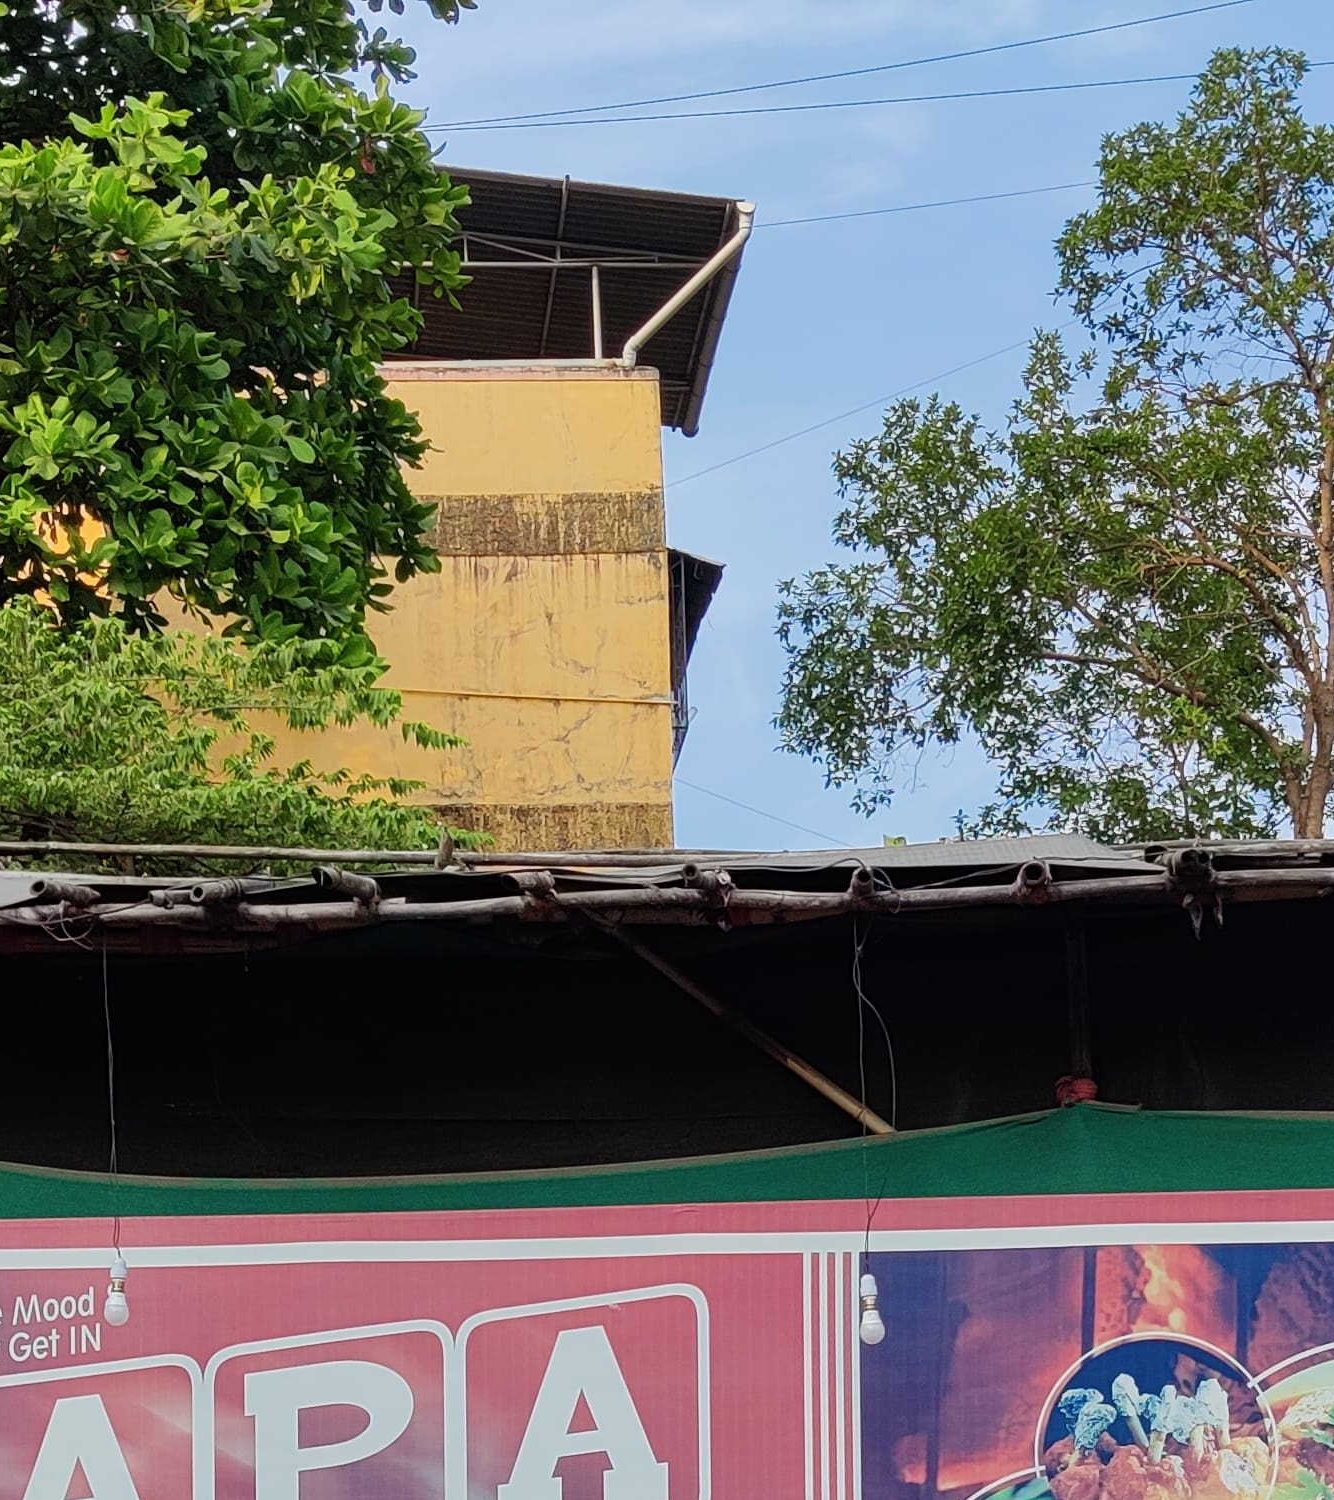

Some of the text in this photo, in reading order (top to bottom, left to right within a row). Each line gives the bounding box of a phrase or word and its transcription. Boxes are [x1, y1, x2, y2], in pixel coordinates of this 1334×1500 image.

[12, 1286, 95, 1327] Mood
[8, 1328, 60, 1362] Get
[70, 1322, 102, 1356] IN
